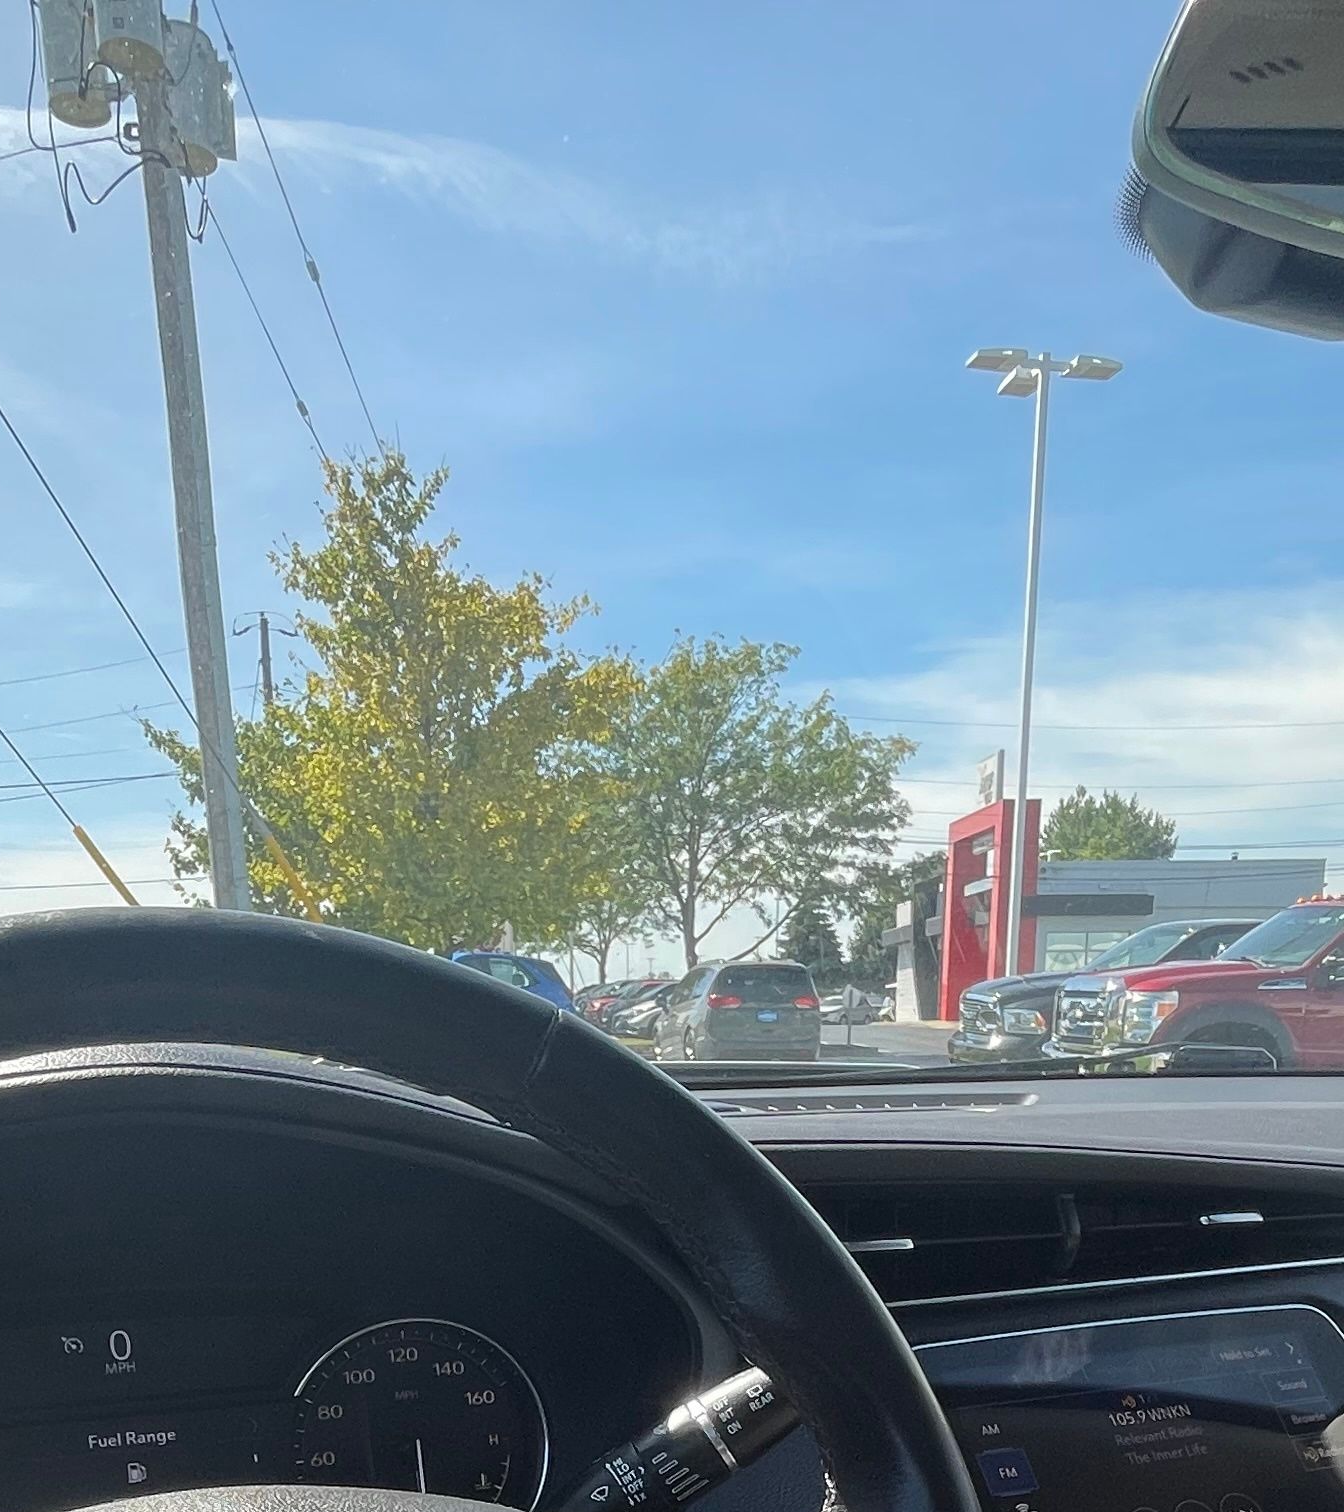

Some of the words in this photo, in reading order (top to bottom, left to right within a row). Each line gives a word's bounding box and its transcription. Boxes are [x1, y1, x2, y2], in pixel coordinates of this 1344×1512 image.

[108, 1329, 132, 1361] 0
[387, 1347, 418, 1363] 120
[105, 1361, 136, 1375] MPH
[432, 1361, 465, 1377] 140
[342, 1368, 376, 1385] 100
[464, 1390, 496, 1406] 160
[712, 1397, 729, 1412] OFF
[748, 1392, 775, 1412] REAR
[317, 1404, 343, 1420] 80
[719, 1408, 734, 1423] INT
[1108, 1409, 1147, 1427] 105.9
[1147, 1404, 1192, 1422] WNKN
[726, 1420, 743, 1435] ON
[981, 1423, 1001, 1436] AM
[87, 1432, 122, 1450] Fuel
[125, 1430, 177, 1446] Range
[1115, 1430, 1167, 1446] Relevant
[310, 1451, 336, 1467] 60
[1126, 1451, 1151, 1465] The
[616, 1463, 630, 1476] LO
[621, 1470, 637, 1485] INT
[998, 1467, 1018, 1480] FM
[627, 1480, 644, 1494] OFF
